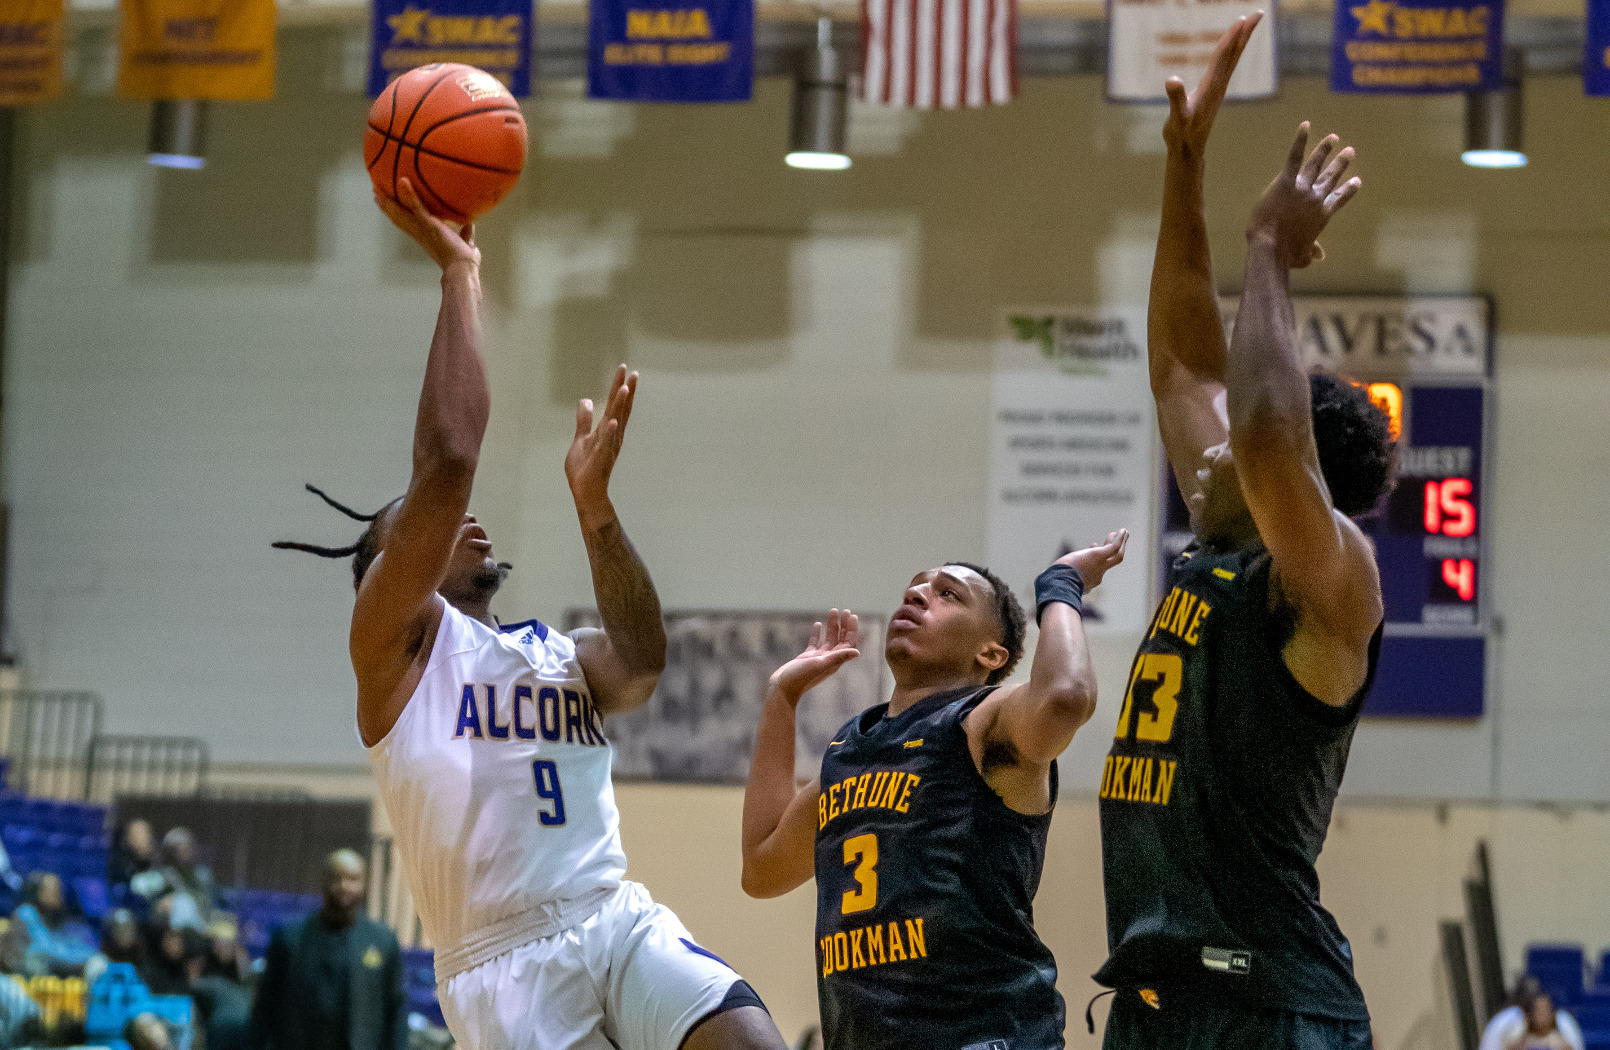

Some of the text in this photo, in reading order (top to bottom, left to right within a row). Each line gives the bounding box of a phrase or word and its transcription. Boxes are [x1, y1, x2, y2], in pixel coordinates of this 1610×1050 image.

[1394, 7, 1489, 37] SWAC
[1399, 447, 1471, 476] UEST
[1424, 478, 1476, 537] 15
[1442, 558, 1475, 601] 4
[1114, 653, 1183, 742] 13
[531, 758, 567, 828] 9
[818, 772, 921, 831] BETHUNE
[841, 833, 879, 915] 3
[820, 918, 928, 979] OOKMAN
